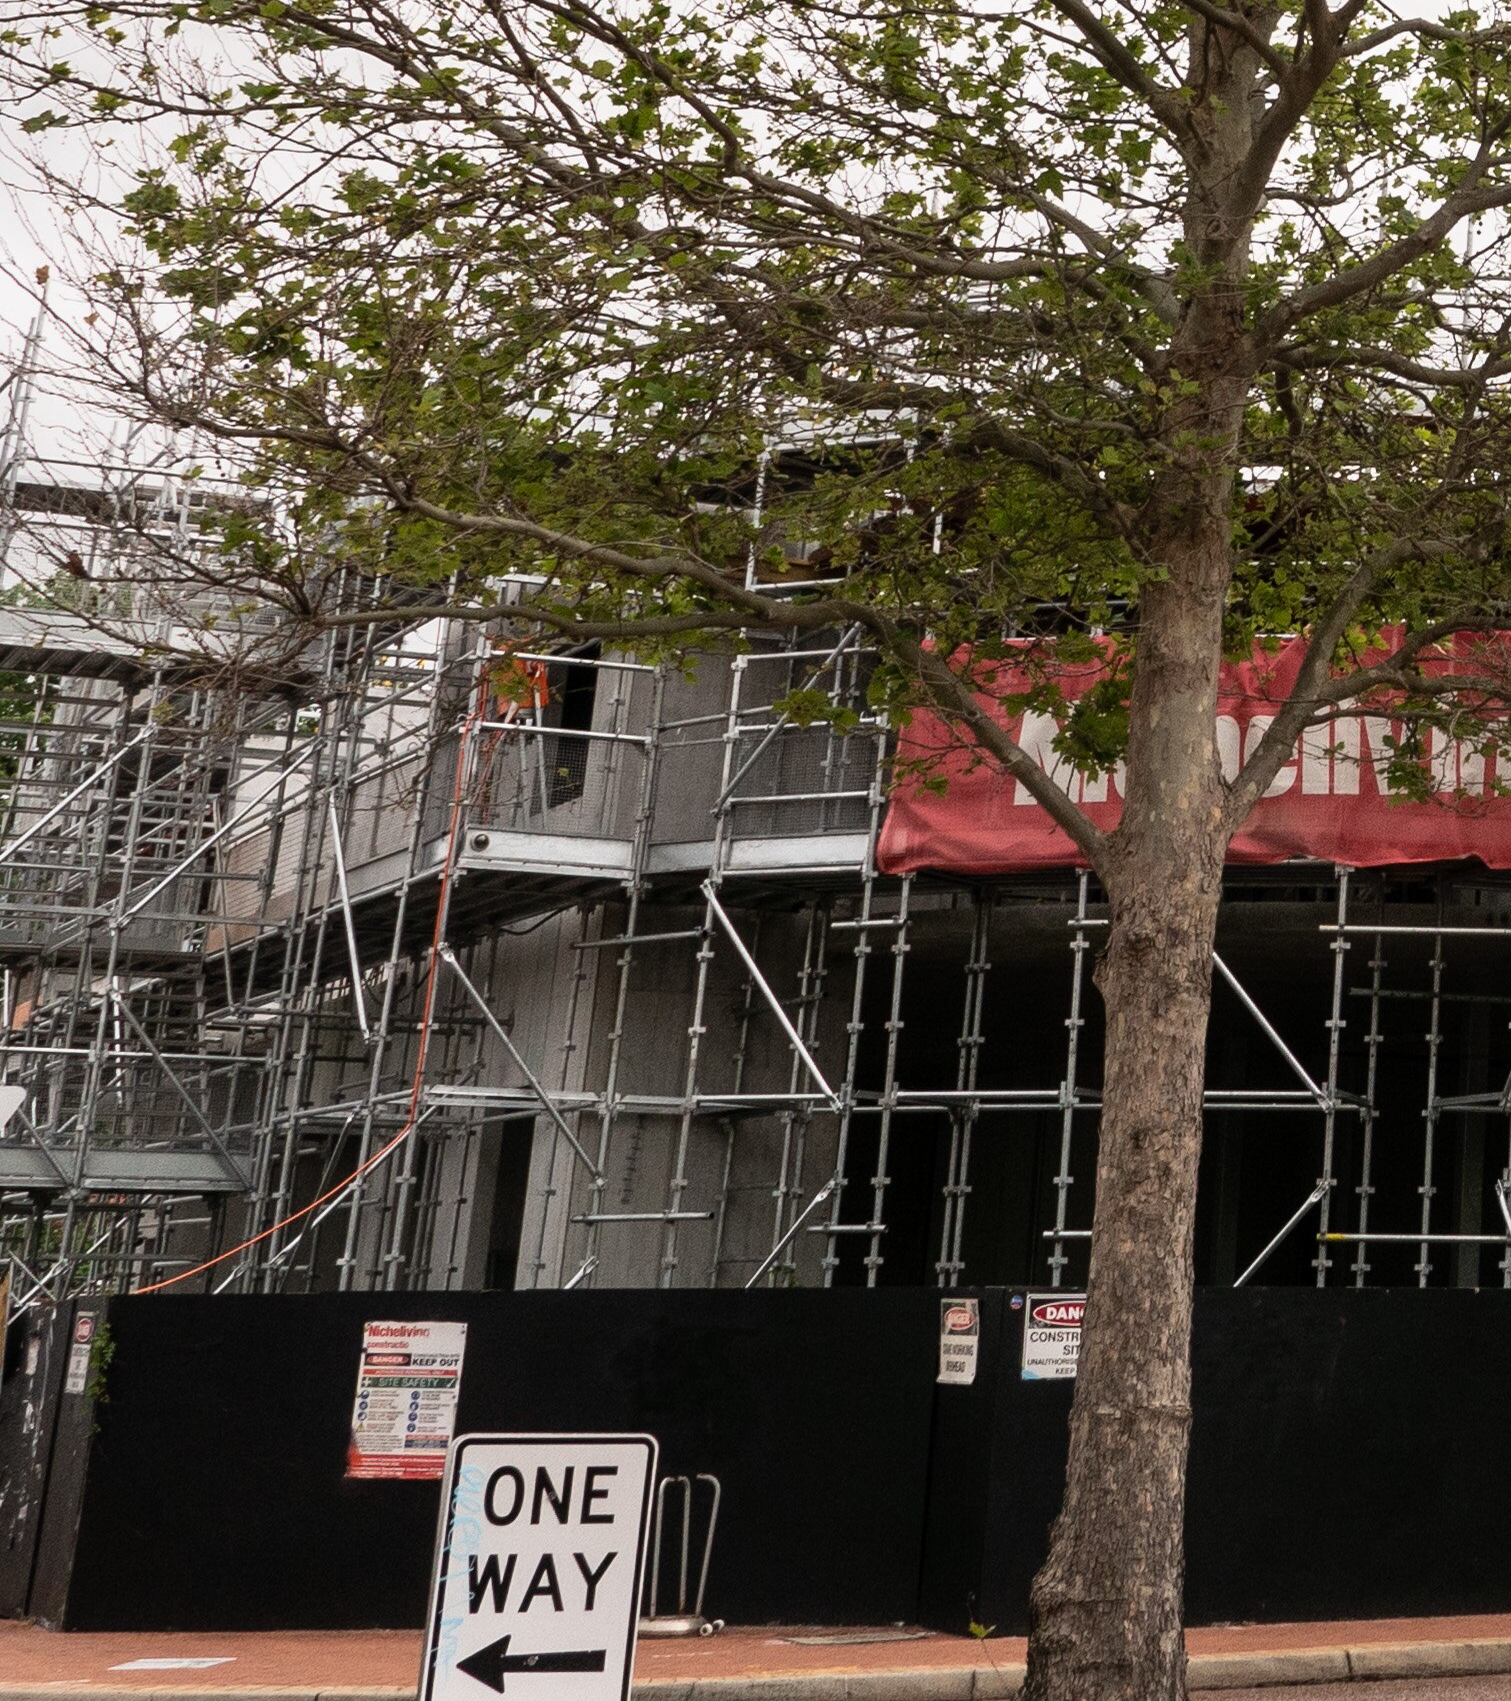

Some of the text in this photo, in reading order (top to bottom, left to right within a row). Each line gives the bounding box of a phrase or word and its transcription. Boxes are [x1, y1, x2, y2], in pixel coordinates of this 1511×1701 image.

[413, 1358, 437, 1366] KEEP
[379, 1377, 439, 1388] SITE SAFETY
[484, 1465, 619, 1527] ONE
[468, 1551, 619, 1615] WAY
